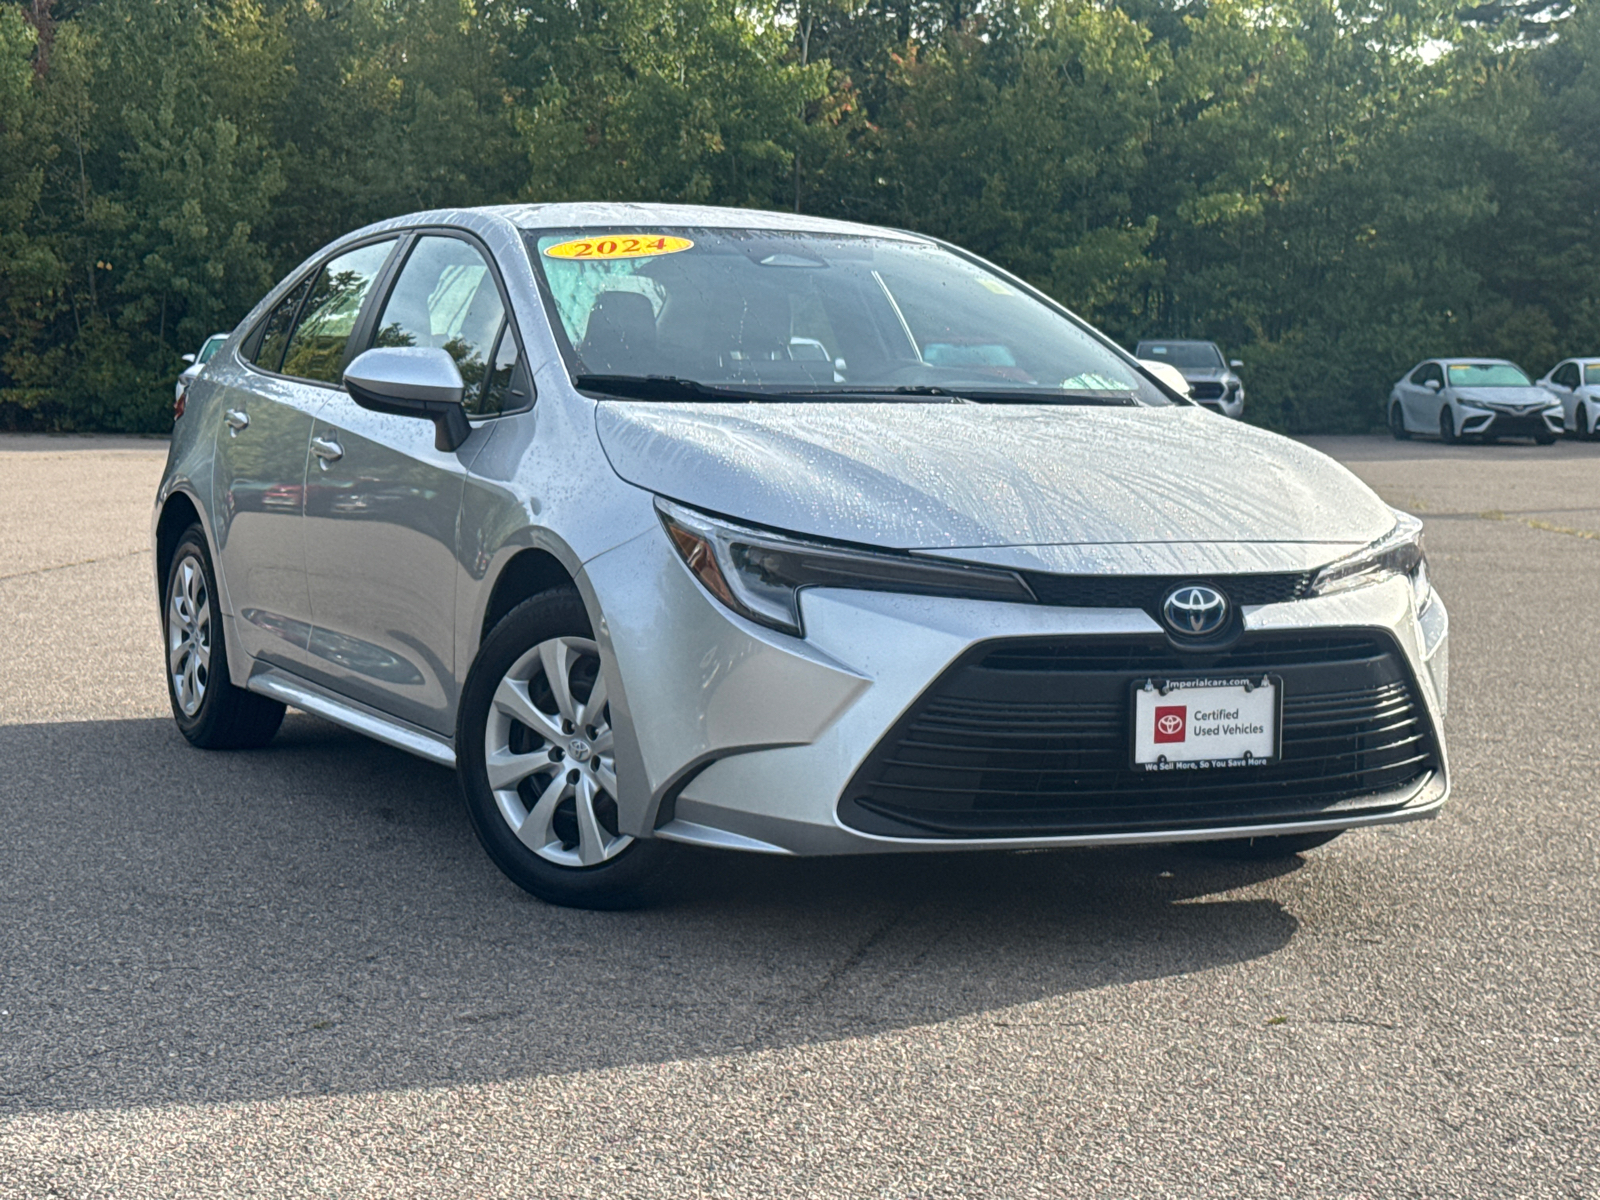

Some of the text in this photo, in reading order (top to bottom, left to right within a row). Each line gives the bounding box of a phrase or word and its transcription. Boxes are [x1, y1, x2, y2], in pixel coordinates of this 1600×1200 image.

[574, 238, 667, 257] 2024
[1165, 678, 1250, 689] Imperialcars.com
[1194, 708, 1239, 721] Certified
[1194, 723, 1264, 736] Used Vehicles
[1145, 758, 1267, 771] We Sell More, So You Save More
